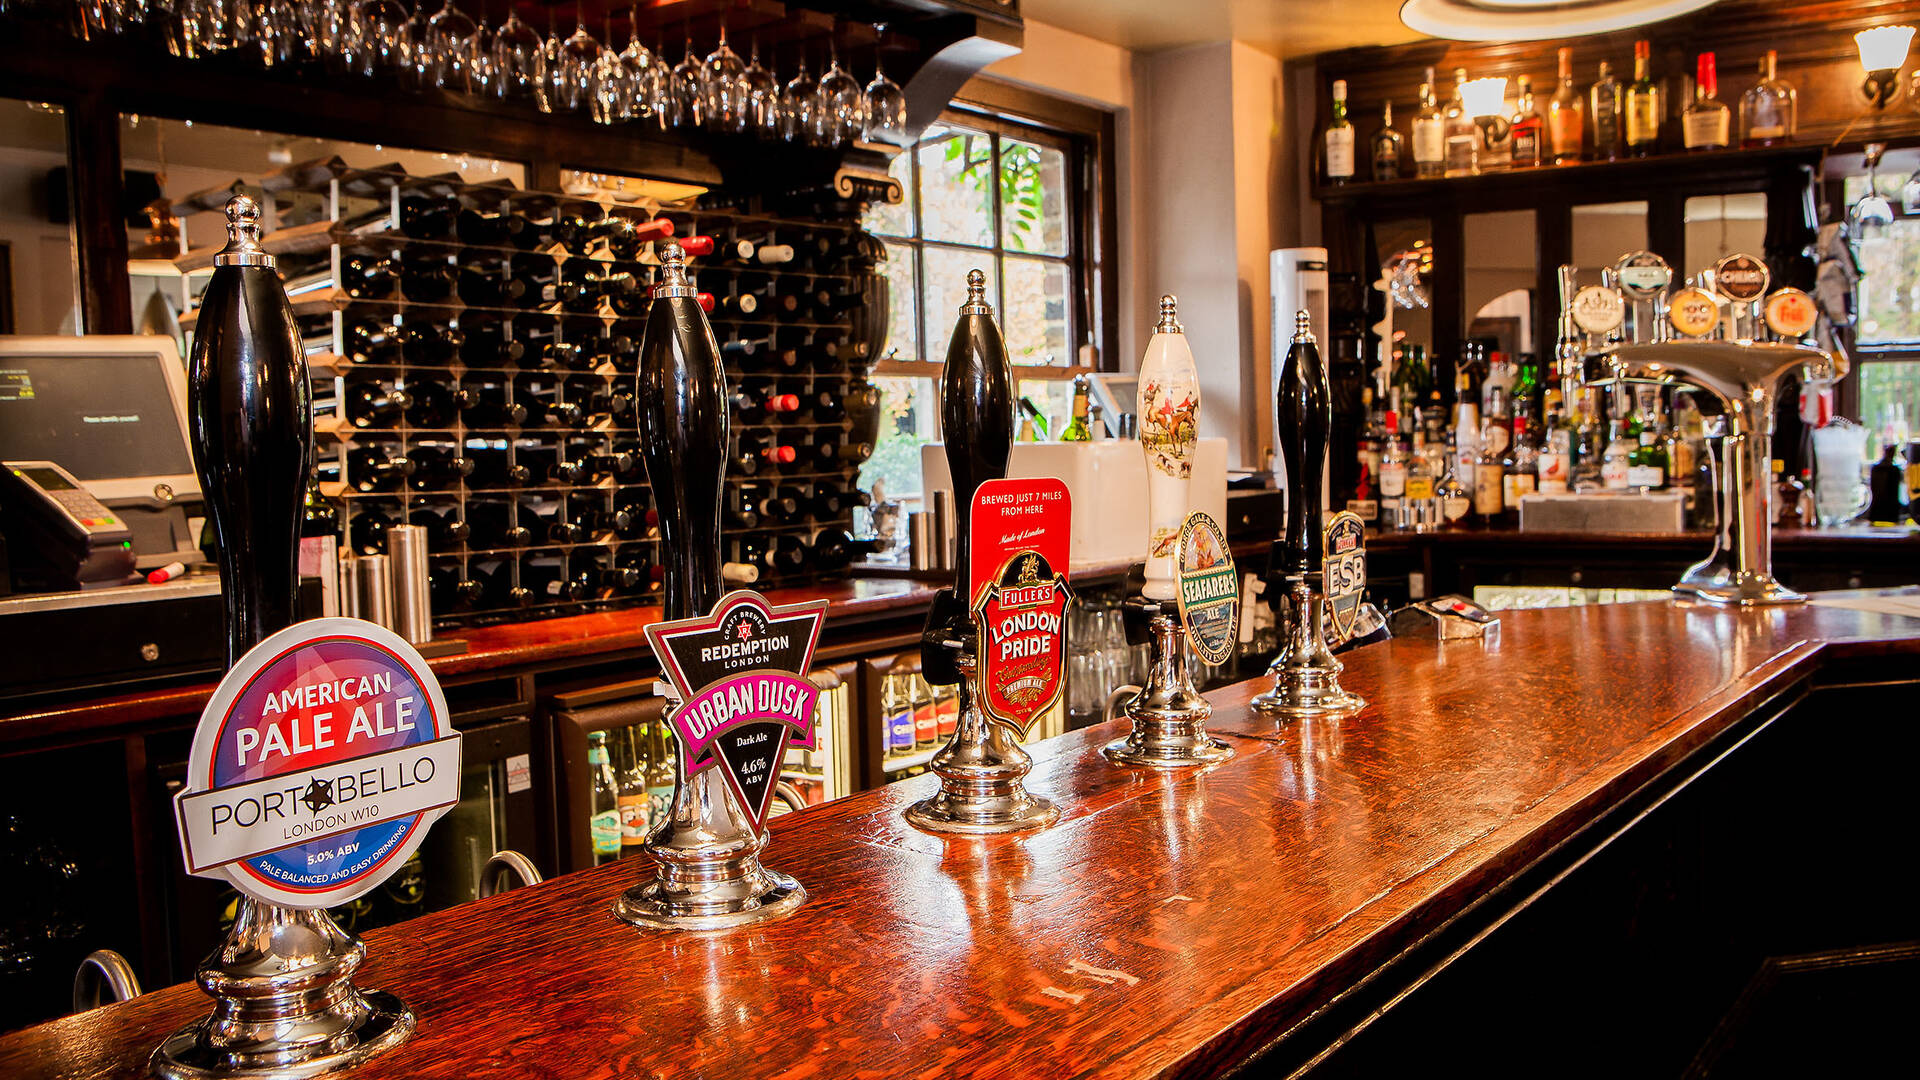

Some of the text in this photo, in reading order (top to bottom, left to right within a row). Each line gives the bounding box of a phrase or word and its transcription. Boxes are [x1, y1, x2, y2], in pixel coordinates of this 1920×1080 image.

[981, 491, 1062, 505] BREWED JUST 7 MILES
[1001, 505, 1043, 516] FROM HERE
[1016, 530, 1024, 542] of
[1023, 527, 1045, 539] London
[1183, 573, 1235, 604] SEAFARERS
[1329, 555, 1365, 596] ESB
[1004, 587, 1050, 605] FULLER'S
[724, 611, 766, 640] CRAFT BREWERY
[990, 611, 1061, 645] LONDON
[1207, 608, 1220, 621] ALE
[701, 635, 789, 662] REDEMPTION
[1000, 634, 1051, 662] PRIDE
[725, 655, 770, 669] LONDON
[262, 672, 391, 716] AMERICAN
[685, 680, 809, 740] URBAN DUSK
[236, 696, 416, 767] PALE ALE
[736, 733, 768, 747] Dark Ale
[741, 757, 767, 775] 4.6%
[745, 774, 763, 785] ABV
[211, 756, 436, 836] PORTOBELLO
[284, 804, 380, 840] LONDON W10
[259, 824, 407, 884] PALE BALANCED AND EASY DRINKING
[307, 842, 360, 866] 5.0% ABV
